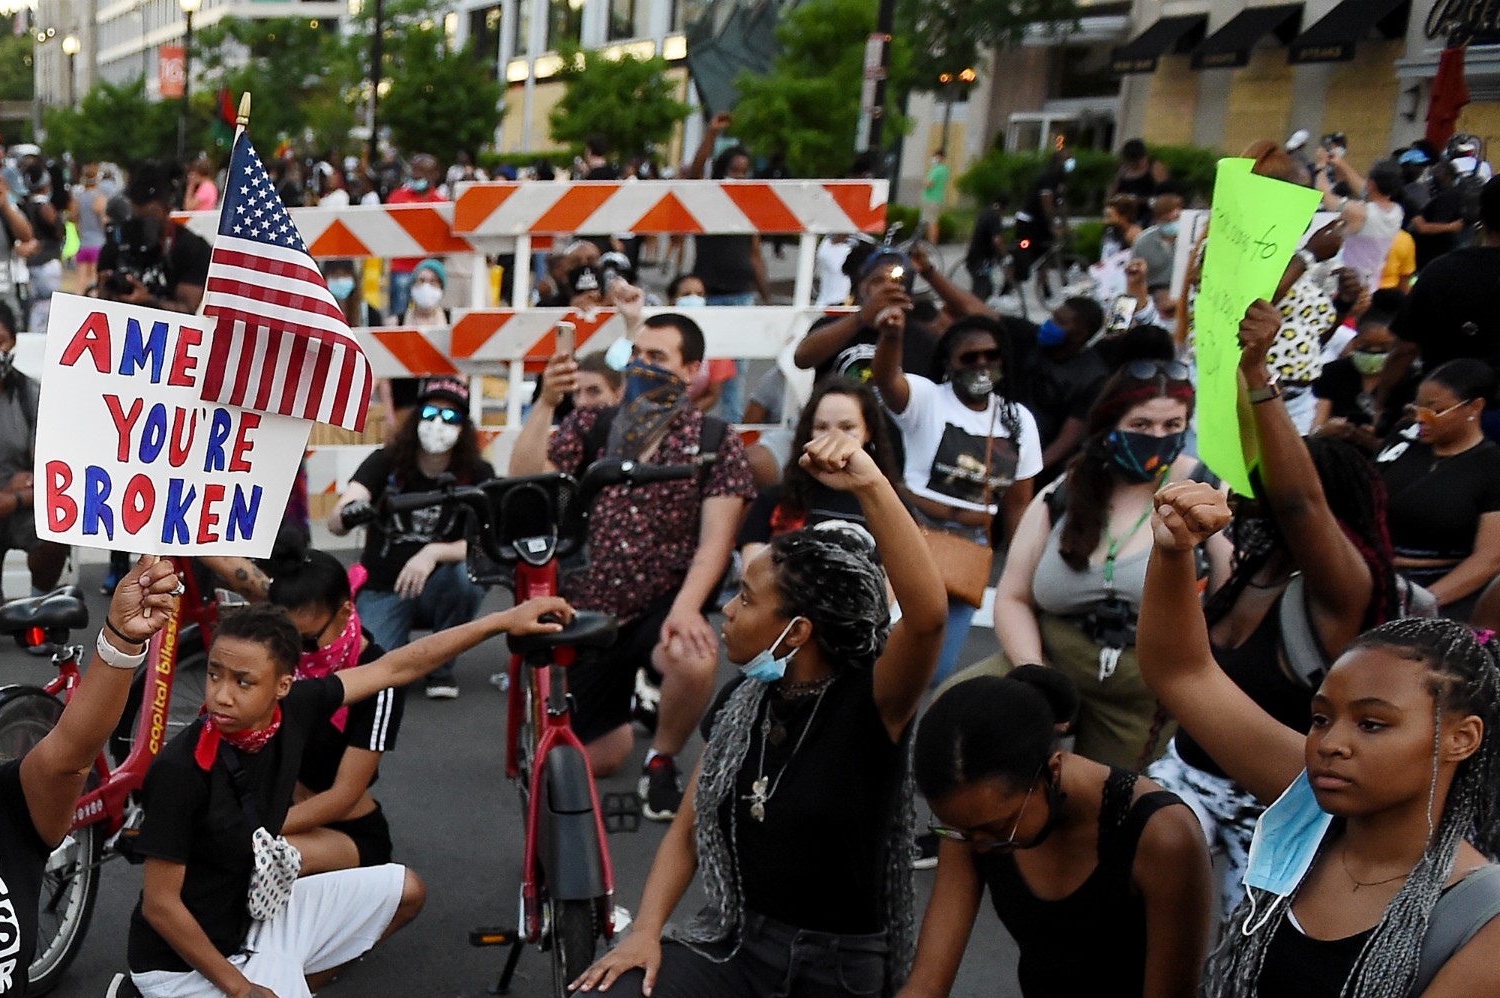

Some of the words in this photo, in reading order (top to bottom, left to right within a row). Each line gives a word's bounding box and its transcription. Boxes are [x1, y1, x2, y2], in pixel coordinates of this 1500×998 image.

[102, 393, 262, 473] YOU'RE
[45, 459, 263, 545] BROKEN
[149, 680, 168, 755] capital
